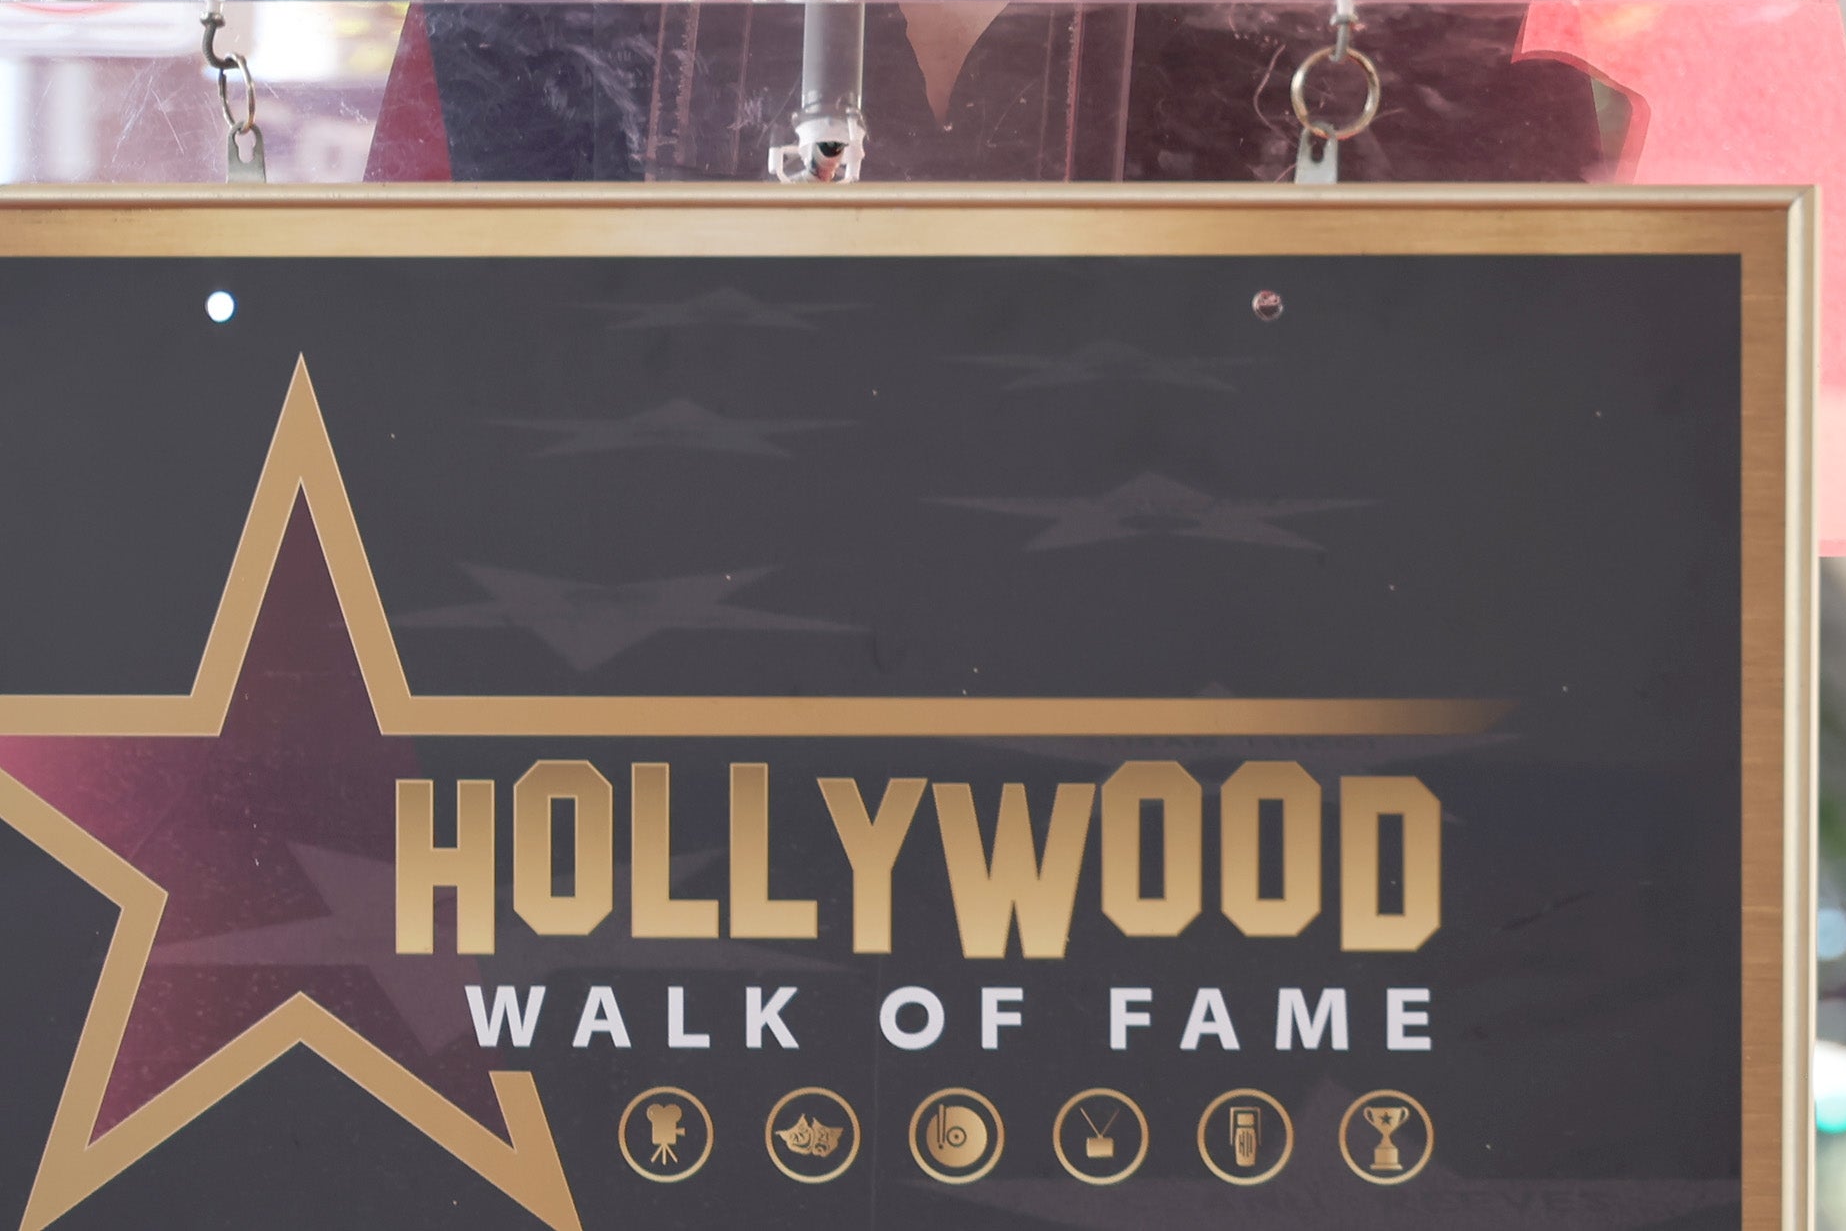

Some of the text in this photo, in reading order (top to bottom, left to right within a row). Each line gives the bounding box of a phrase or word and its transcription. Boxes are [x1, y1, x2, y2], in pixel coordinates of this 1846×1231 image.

[395, 760, 1440, 959] HOLLYWOOD
[465, 986, 1431, 1049] WALK OF FAME
